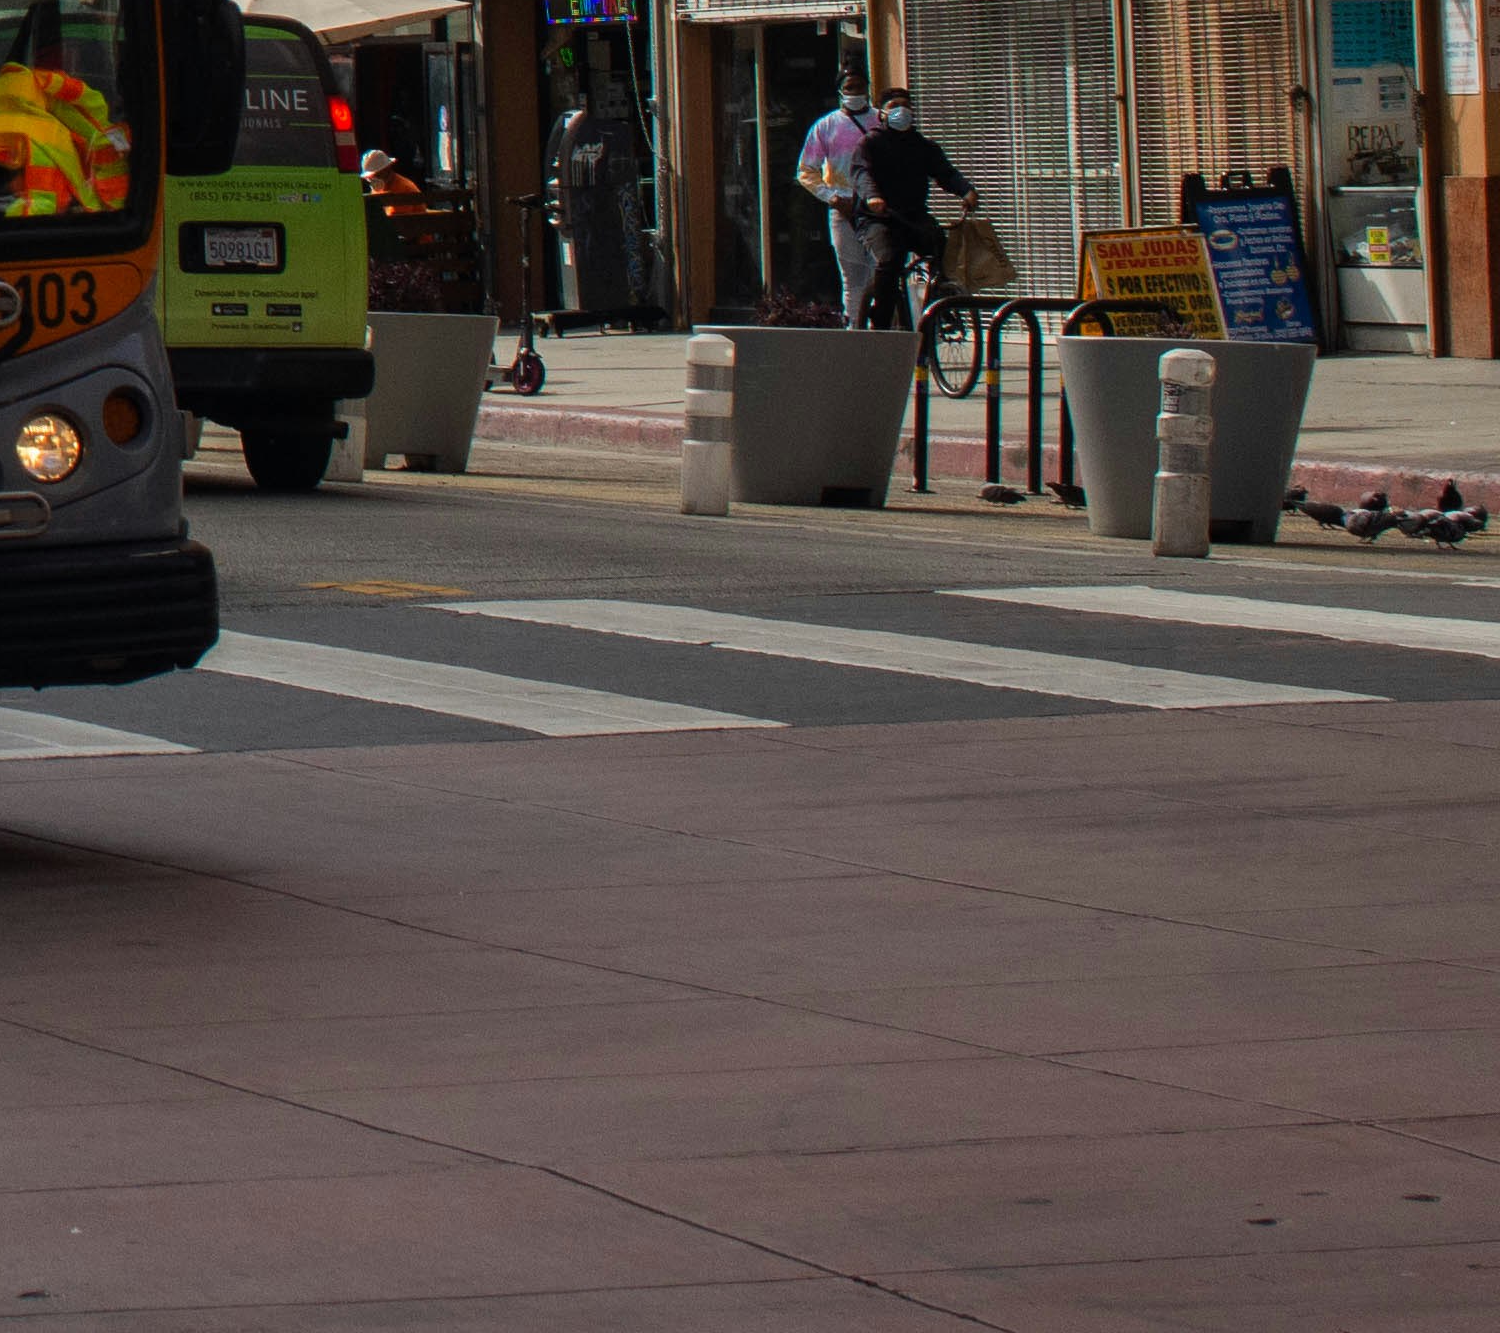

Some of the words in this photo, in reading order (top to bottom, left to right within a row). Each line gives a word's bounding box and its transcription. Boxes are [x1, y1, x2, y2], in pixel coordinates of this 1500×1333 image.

[243, 89, 309, 111] LINE
[1096, 242, 1134, 258] SAN
[1140, 239, 1199, 256] JUDAS
[1102, 256, 1200, 271] JEWELRY
[1117, 276, 1143, 294] POR
[1145, 273, 1200, 293] EFECTIVO
